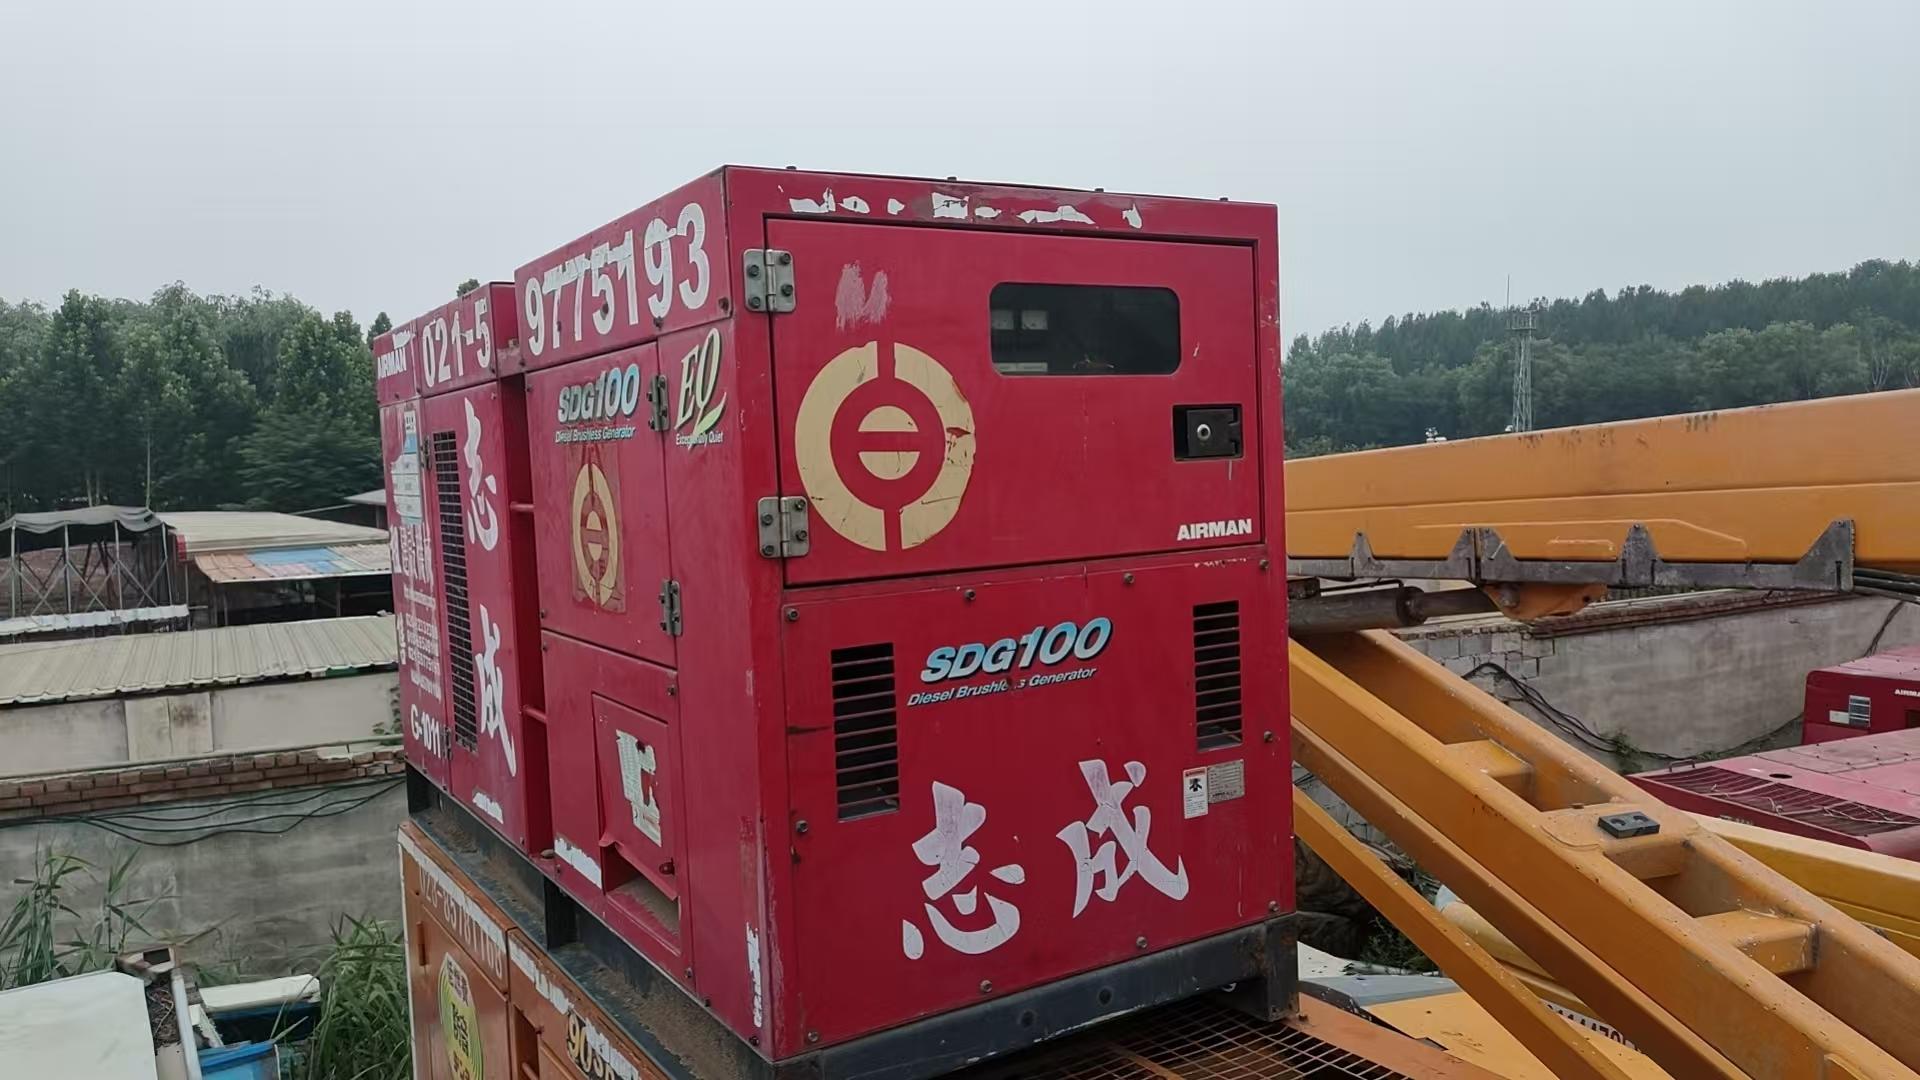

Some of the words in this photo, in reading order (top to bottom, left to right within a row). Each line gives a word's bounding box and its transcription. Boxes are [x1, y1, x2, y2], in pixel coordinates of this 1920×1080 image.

[525, 203, 710, 356] 9775193
[558, 363, 640, 423] SDG100
[572, 428, 602, 442] Brushless
[602, 425, 636, 440] Generator
[708, 431, 723, 443] Quiet
[1177, 518, 1252, 541] AIRMAN
[920, 617, 1113, 684] SDG100
[906, 687, 955, 707] Diesel
[957, 676, 1025, 699] Brushles
[1028, 667, 1097, 688] Generator
